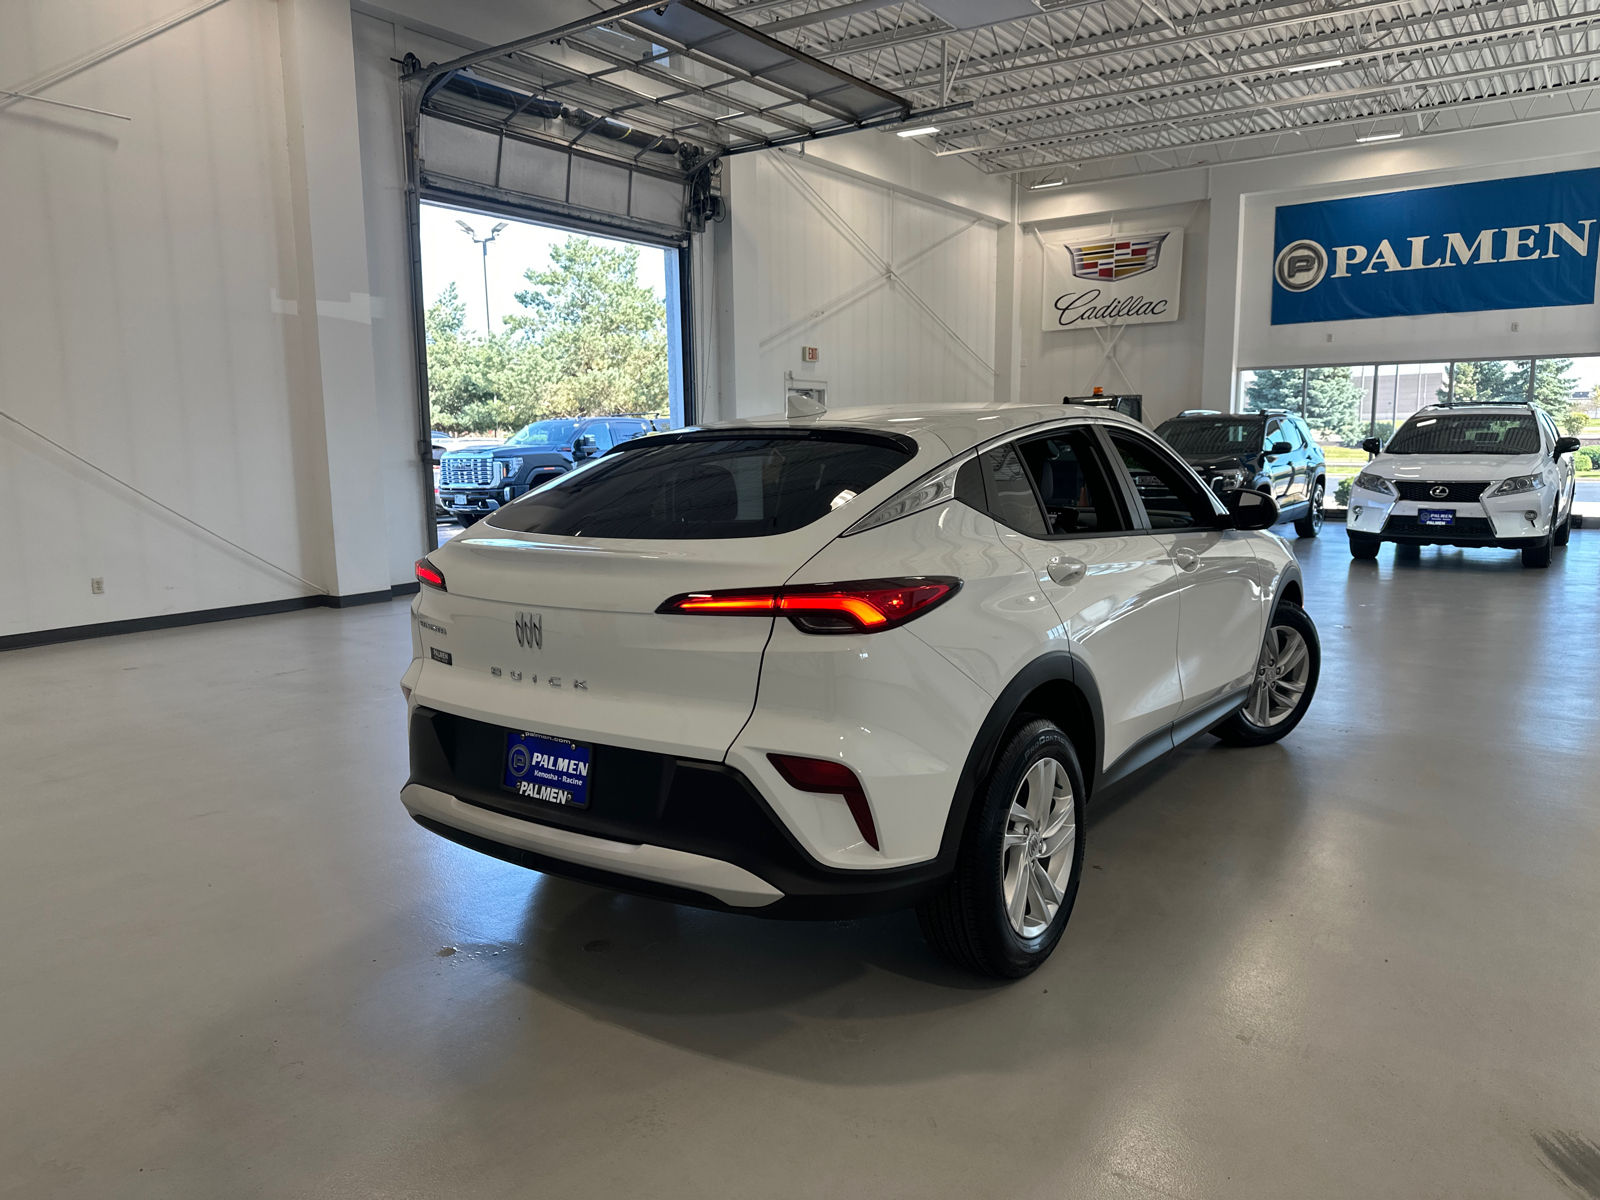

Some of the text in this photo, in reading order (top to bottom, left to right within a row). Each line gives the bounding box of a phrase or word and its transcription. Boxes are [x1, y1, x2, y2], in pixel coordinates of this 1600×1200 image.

[1330, 219, 1597, 278] PALMEN
[1054, 288, 1168, 326] Cadillac
[491, 666, 588, 690] BUICK
[525, 731, 570, 744] palmen.com
[531, 752, 589, 776] PALMEN
[534, 769, 558, 781] Kenosha
[562, 775, 583, 786] Racine
[519, 781, 568, 805] PALMEN
